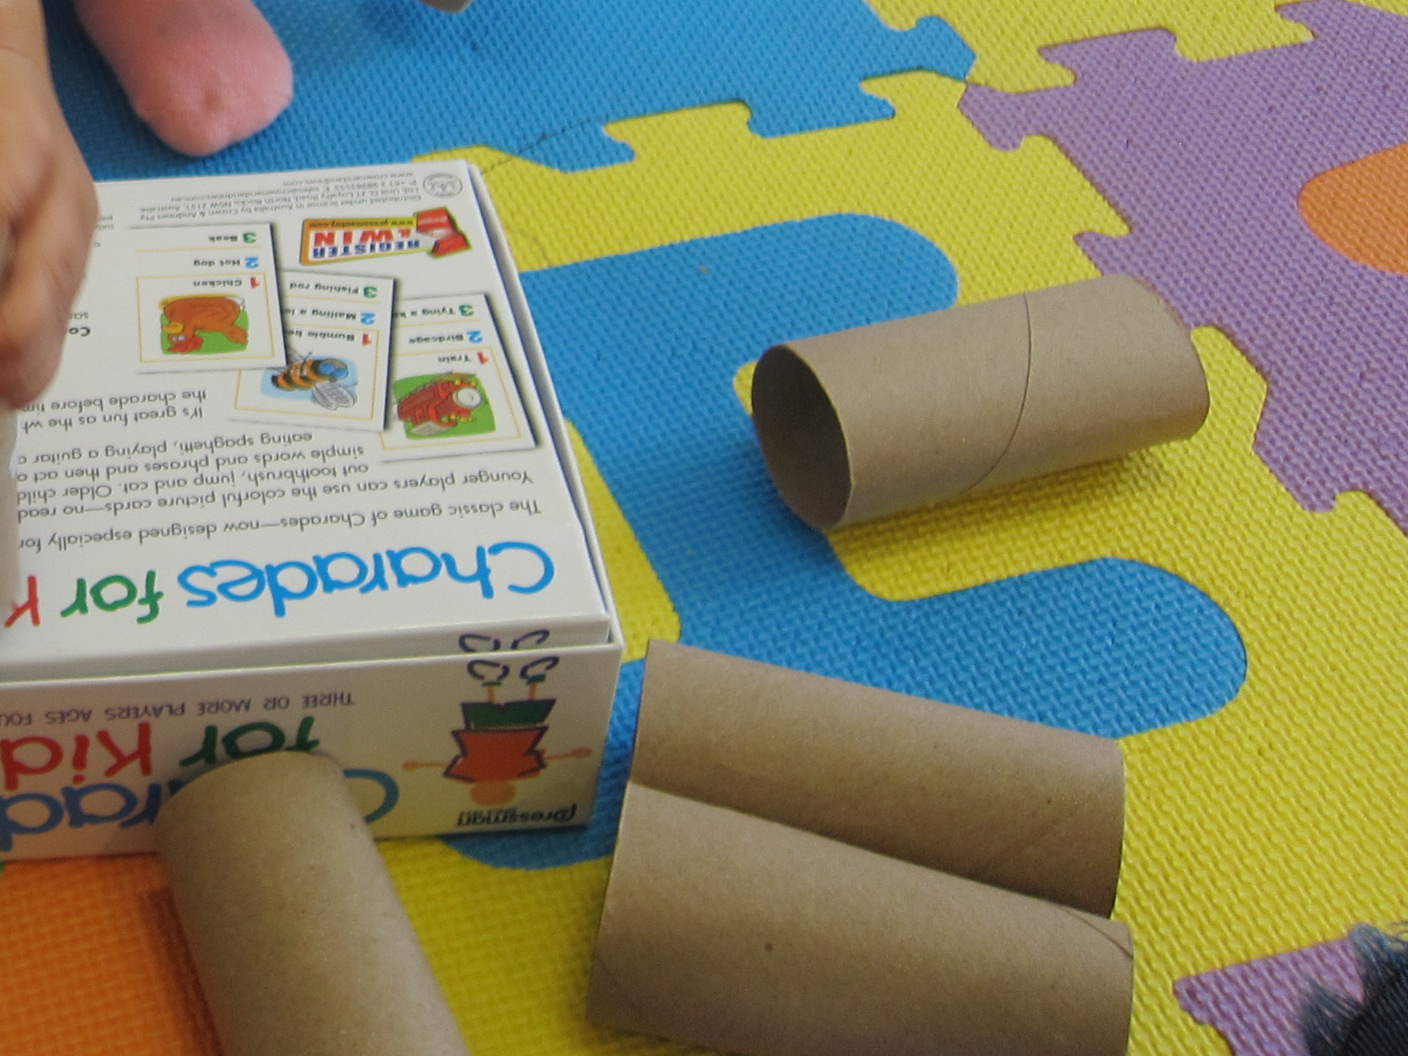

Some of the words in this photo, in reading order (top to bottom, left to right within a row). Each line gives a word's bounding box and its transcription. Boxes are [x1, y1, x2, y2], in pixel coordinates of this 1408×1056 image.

[243, 232, 257, 244] 3
[314, 229, 394, 247] WIN
[312, 240, 420, 259] REGISTER
[245, 257, 259, 269] 2
[193, 280, 242, 288] Chicken
[250, 277, 260, 289] 1
[289, 282, 310, 291] rod
[314, 283, 359, 294] Fishing
[363, 286, 378, 298] 3
[312, 309, 357, 320] Mailing
[422, 307, 456, 317] Tying
[458, 304, 474, 317] 3
[360, 313, 376, 325] 2
[307, 331, 355, 342] Bumble
[362, 333, 373, 346] 1
[409, 334, 464, 345] Birdcage
[466, 330, 483, 344] 2
[438, 354, 471, 363] Train
[477, 352, 490, 365] 1
[109, 392, 176, 409] charade
[182, 389, 207, 404] the
[51, 398, 103, 414] before
[78, 415, 97, 426] as
[103, 413, 128, 427] fun
[133, 406, 177, 422] great
[182, 407, 202, 421] It's
[48, 417, 73, 432] the
[173, 434, 254, 455] spaghetti,
[260, 432, 312, 447] eating
[33, 448, 82, 465] guitar
[88, 449, 99, 459] a
[105, 441, 167, 459] playing
[311, 445, 364, 463] simple
[144, 455, 209, 474] phrases
[215, 455, 248, 472] and
[254, 452, 305, 468] words
[33, 471, 58, 483] act
[65, 467, 100, 482] then
[106, 464, 138, 481] and
[242, 466, 337, 487] toothbrush,
[342, 464, 369, 477] out
[155, 478, 187, 494] and
[193, 471, 236, 488] jump
[394, 472, 456, 492] players
[461, 470, 533, 487] Younger
[62, 484, 112, 501] Older
[118, 481, 149, 495] cat.
[291, 486, 317, 502] the
[323, 483, 351, 494] use
[357, 481, 388, 493] can
[158, 491, 216, 509] picture
[222, 488, 286, 508] colorful
[393, 503, 443, 521] game
[448, 503, 504, 519] classic
[509, 500, 541, 516] The
[371, 510, 388, 527] of
[48, 528, 132, 552] especially
[139, 523, 217, 545] designed
[19, 538, 42, 553] for
[177, 541, 554, 618] Charades
[60, 570, 164, 624] for
[263, 696, 290, 710] OR
[302, 692, 355, 705] THREE
[104, 702, 185, 721] PLAYERS
[197, 698, 251, 716] MORE
[45, 708, 92, 724] AGES
